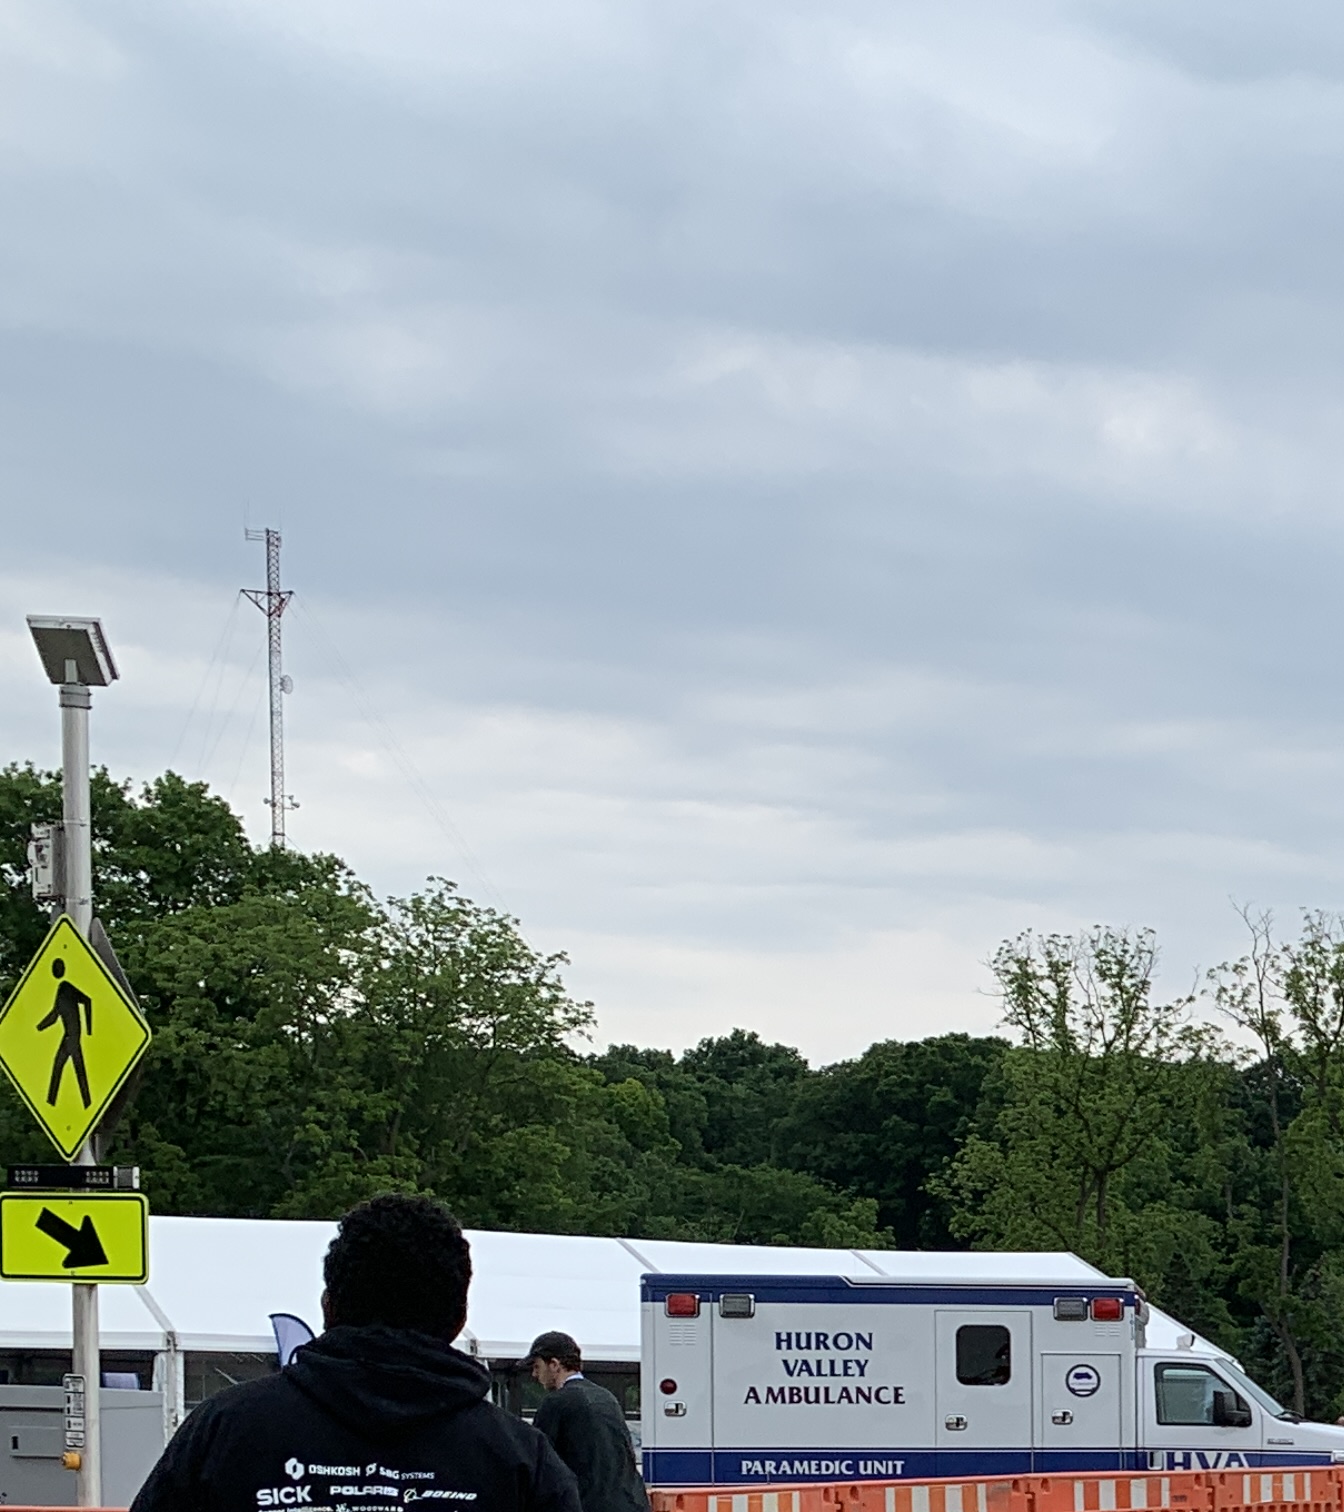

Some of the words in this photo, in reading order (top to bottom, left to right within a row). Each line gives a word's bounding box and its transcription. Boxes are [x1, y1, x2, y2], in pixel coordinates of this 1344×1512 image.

[775, 1332, 873, 1350] HURON
[782, 1359, 869, 1377] VALLEY
[744, 1386, 906, 1404] AMBULANCE
[741, 1460, 854, 1475] PARAMEDIC
[859, 1460, 904, 1474] UNIT
[1164, 1450, 1250, 1470] HVA
[308, 1464, 361, 1476] OSHKOSH
[256, 1485, 312, 1506] SICK
[330, 1486, 399, 1497] POLARIS
